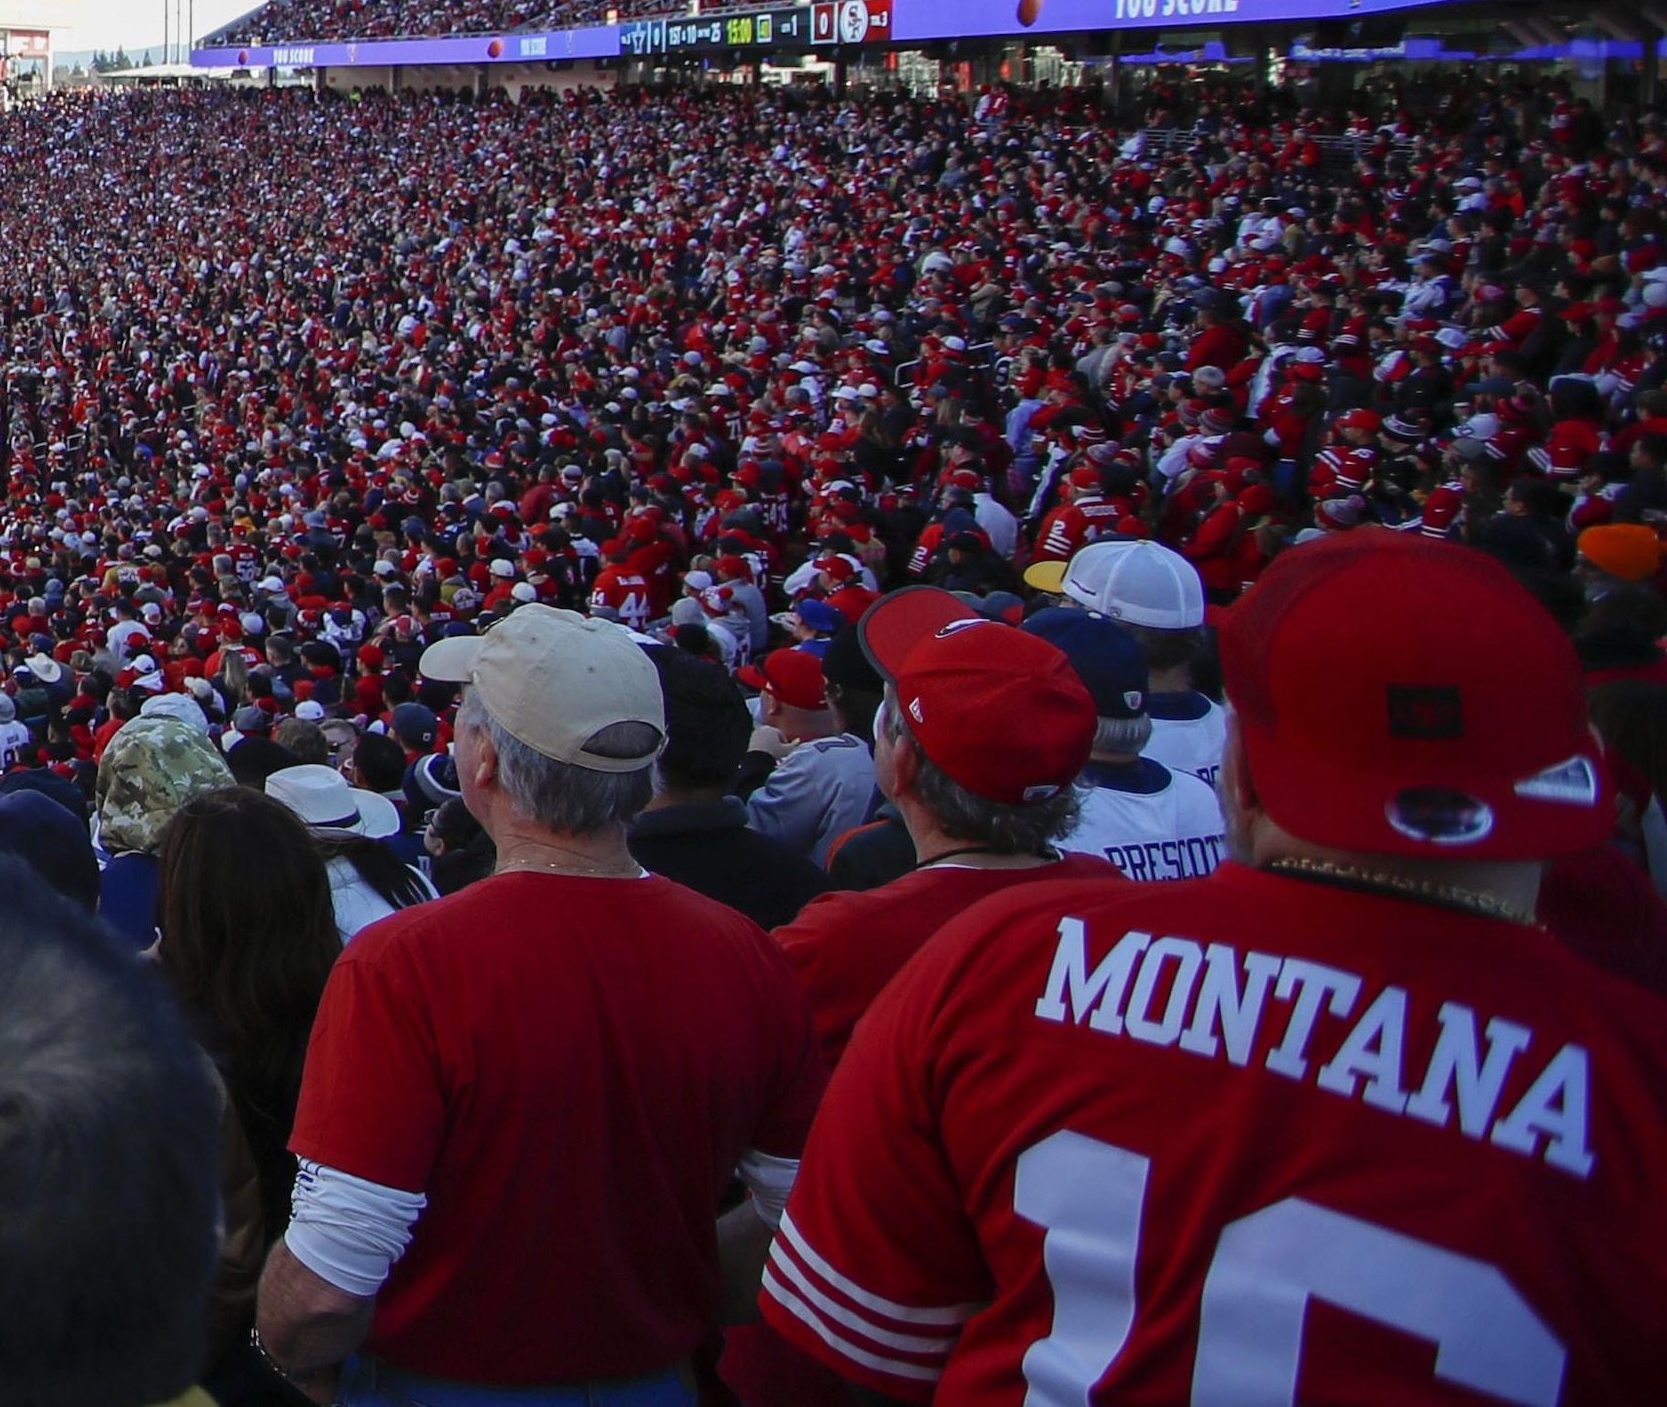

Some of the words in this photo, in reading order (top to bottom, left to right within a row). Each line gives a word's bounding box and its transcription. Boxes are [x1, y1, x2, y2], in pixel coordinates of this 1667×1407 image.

[726, 17, 753, 45] 15:00
[819, 11, 828, 35] 0
[273, 49, 289, 64] YOU
[289, 48, 315, 63] SCORE
[1103, 832, 1225, 883] PRESCOT
[1034, 915, 1597, 1180] MONTANA
